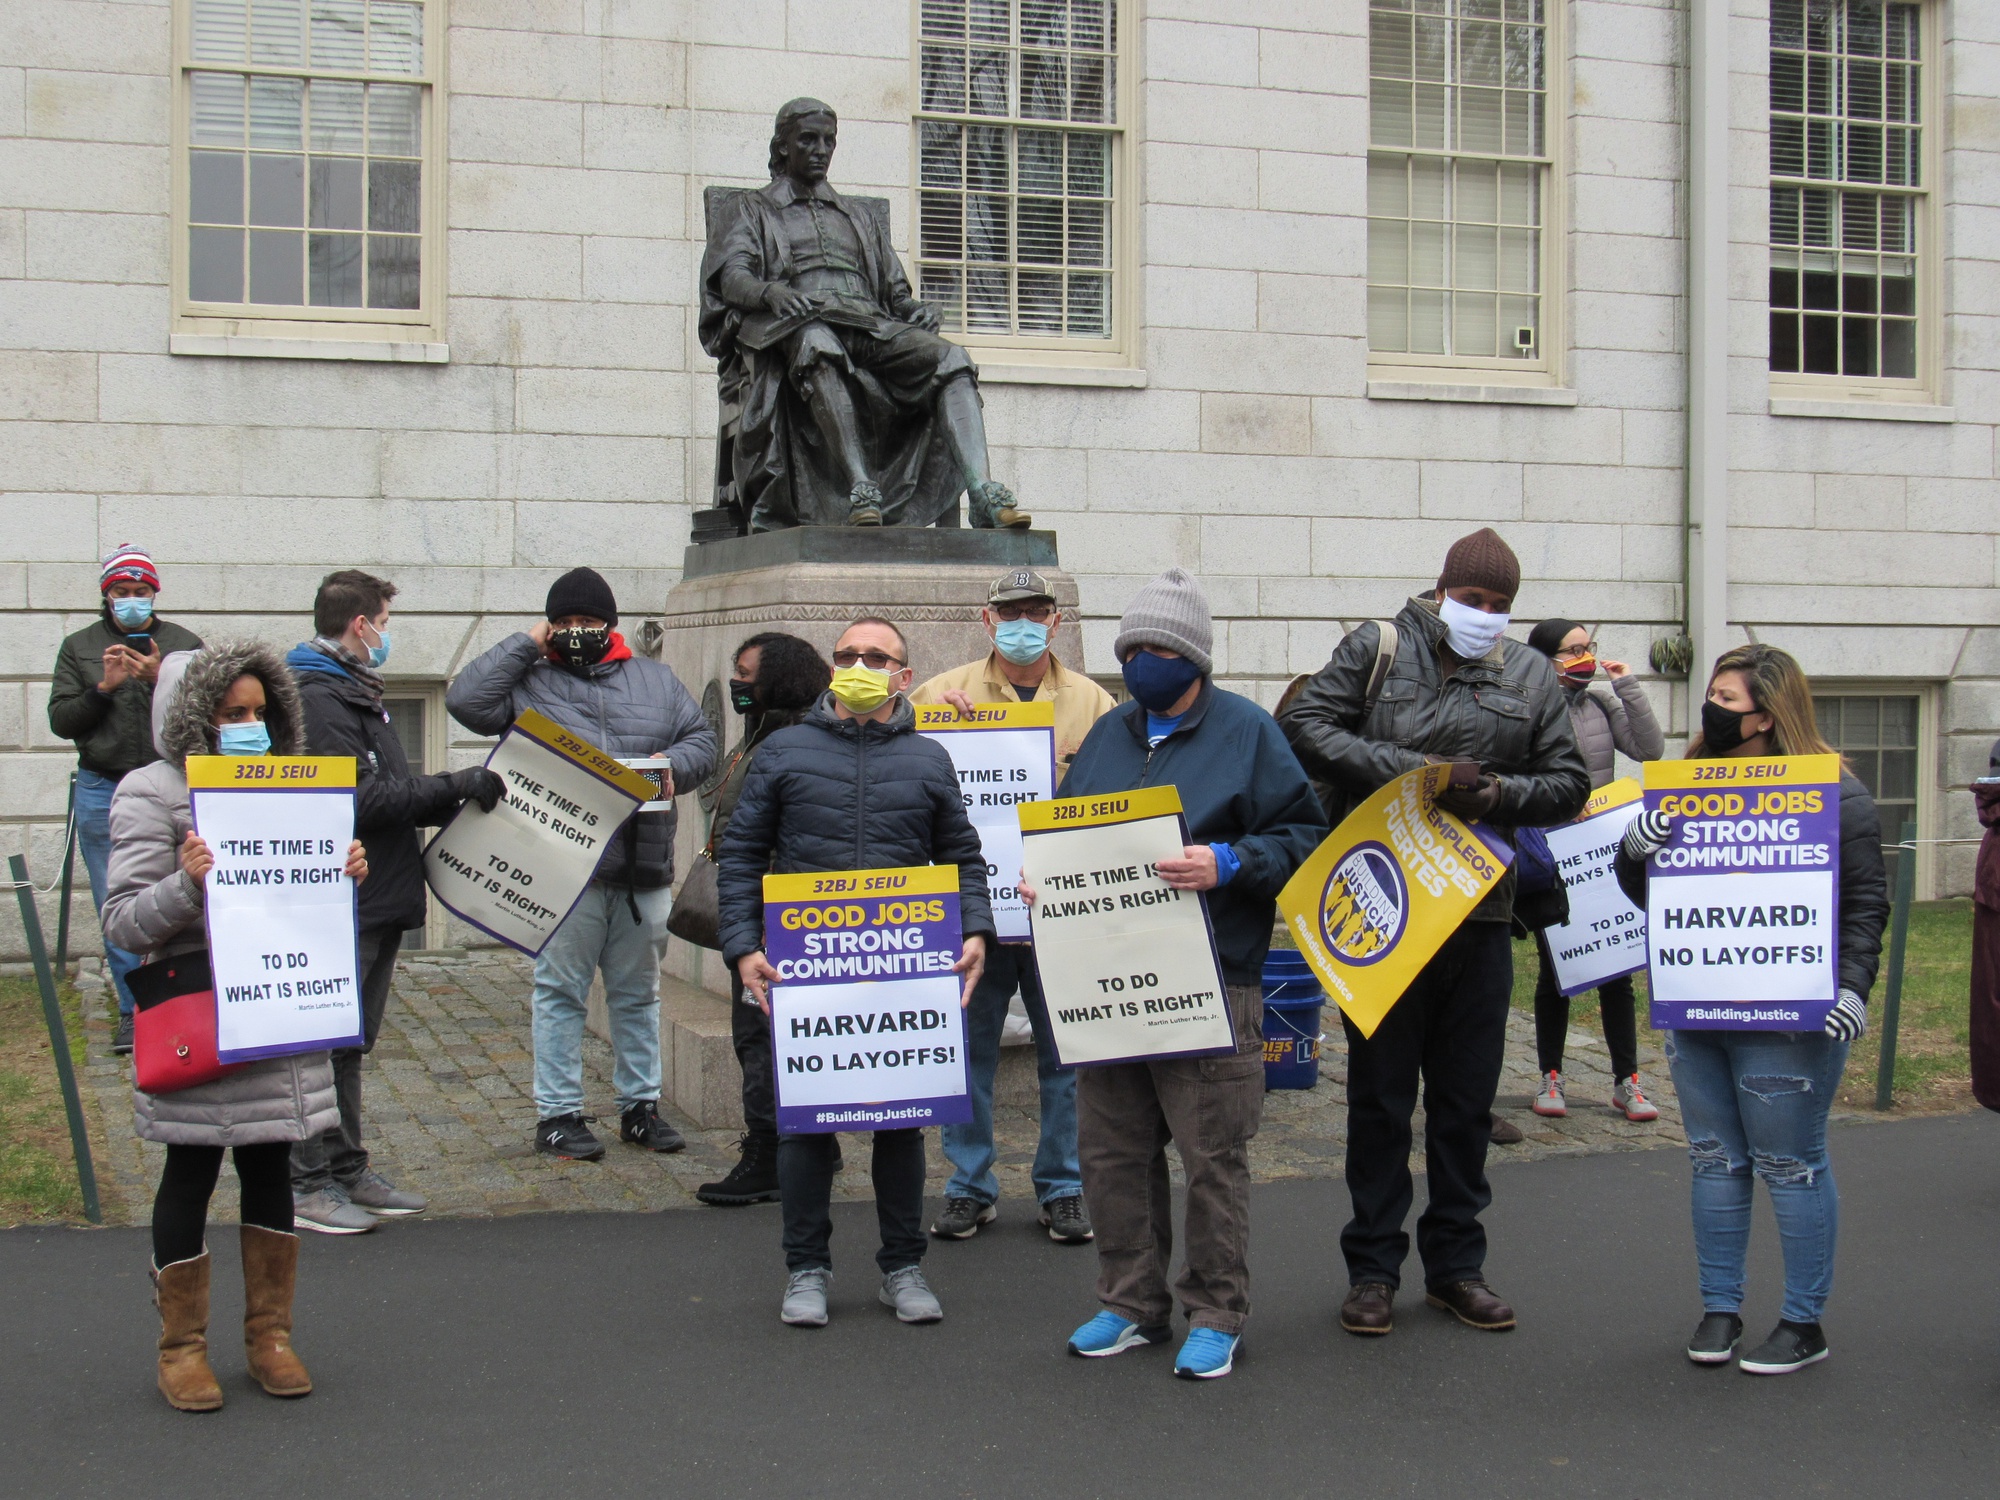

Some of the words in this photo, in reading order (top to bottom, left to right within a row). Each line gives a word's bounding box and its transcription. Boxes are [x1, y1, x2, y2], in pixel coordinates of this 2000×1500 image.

[1013, 572, 1030, 587] B
[921, 711, 962, 724] 32BJ
[967, 709, 1008, 722] SEIU
[553, 734, 586, 758] 32BJ
[588, 754, 624, 778] SEIU
[234, 764, 275, 779] 32BJ
[280, 764, 318, 779] SEIU
[958, 769, 1003, 783] TIME
[1009, 768, 1028, 782] IS
[1693, 765, 1738, 780] 32BJ
[1743, 764, 1788, 779] SEIU
[980, 792, 1039, 806] RIGHT
[1422, 767, 1440, 811] BUENOS
[545, 790, 583, 818] TIME
[583, 811, 600, 827] IS
[1053, 804, 1085, 821] 32BJ
[1091, 799, 1130, 817] SEIU
[1587, 795, 1608, 809] EIU
[1659, 793, 1745, 818] GOOD
[1750, 790, 1824, 816] JOBS
[500, 793, 549, 824] LWAYS
[550, 818, 597, 850] RIGHT
[1682, 818, 1800, 844] STRONG
[269, 839, 313, 855] TIME
[319, 839, 334, 855] IS
[1383, 798, 1448, 898] FUERTES
[1401, 774, 1480, 898] COMUNIDADES
[1427, 807, 1496, 881] EMPLEOS
[1585, 842, 1620, 861] TIME
[1654, 843, 1830, 868] COMMUNITIES
[216, 869, 285, 885] ALWAYS
[291, 867, 342, 884] RIGHT
[438, 848, 484, 883] WHAT
[484, 878, 501, 894] IS
[487, 854, 510, 874] TO
[510, 867, 533, 887] DO
[1090, 865, 1140, 885] TIME
[1564, 867, 1604, 888] WAYS
[813, 878, 858, 893] 32BJ
[864, 875, 908, 890] SEIU
[1353, 853, 1398, 925] BUILDING
[1042, 897, 1115, 919] ALWAYS
[1119, 887, 1180, 909] RIGHT
[1344, 867, 1389, 934] JUSTICIA
[781, 905, 866, 930] GOOD
[871, 899, 945, 926] JOBS
[1590, 921, 1611, 932] TO
[1614, 911, 1635, 926] DO
[1664, 905, 1817, 929] HARVARD!
[804, 927, 924, 956] STRONG
[1559, 940, 1602, 961] WHAT
[1606, 934, 1621, 947] IS
[1624, 925, 1646, 941] RIG
[262, 953, 282, 970] TO
[287, 952, 308, 969] DO
[776, 950, 955, 980] COMMUNITIES
[1294, 913, 1354, 1002] #BuildingJustice
[1659, 948, 1694, 966] NO
[1702, 945, 1823, 965] LAYOFFS!
[225, 984, 272, 1003] WHAT
[277, 982, 292, 999] IS
[1097, 977, 1125, 993] TO
[1130, 972, 1159, 990] DO
[790, 1009, 948, 1039] HARVARD!
[1058, 1004, 1113, 1024] WHAT
[1119, 1001, 1139, 1017] IS
[1686, 1008, 1800, 1022] #BuildingJustice
[787, 1055, 824, 1074] NO
[832, 1046, 955, 1072] LAYOFFS!
[816, 1107, 932, 1124] #BuildingJustice
